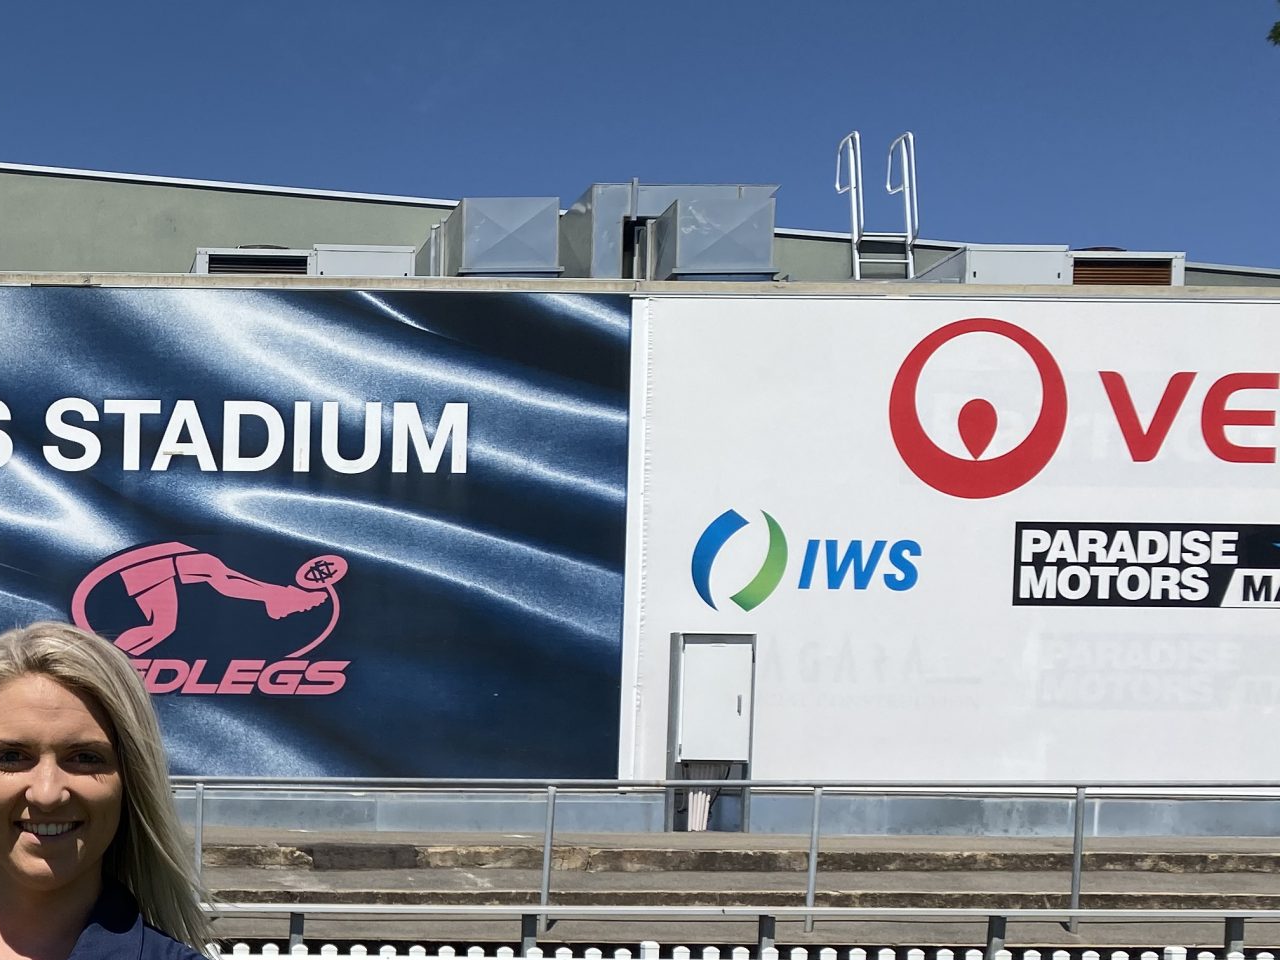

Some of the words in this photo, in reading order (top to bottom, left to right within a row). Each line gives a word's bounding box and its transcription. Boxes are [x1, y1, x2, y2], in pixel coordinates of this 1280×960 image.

[43, 397, 469, 475] STADIUM
[1098, 371, 1280, 464] VE
[797, 538, 923, 592] IWS
[1020, 529, 1239, 565] PARADISE
[1019, 565, 1210, 601] MOTORS
[1242, 575, 1280, 602] M
[128, 658, 352, 695] DLEGS
